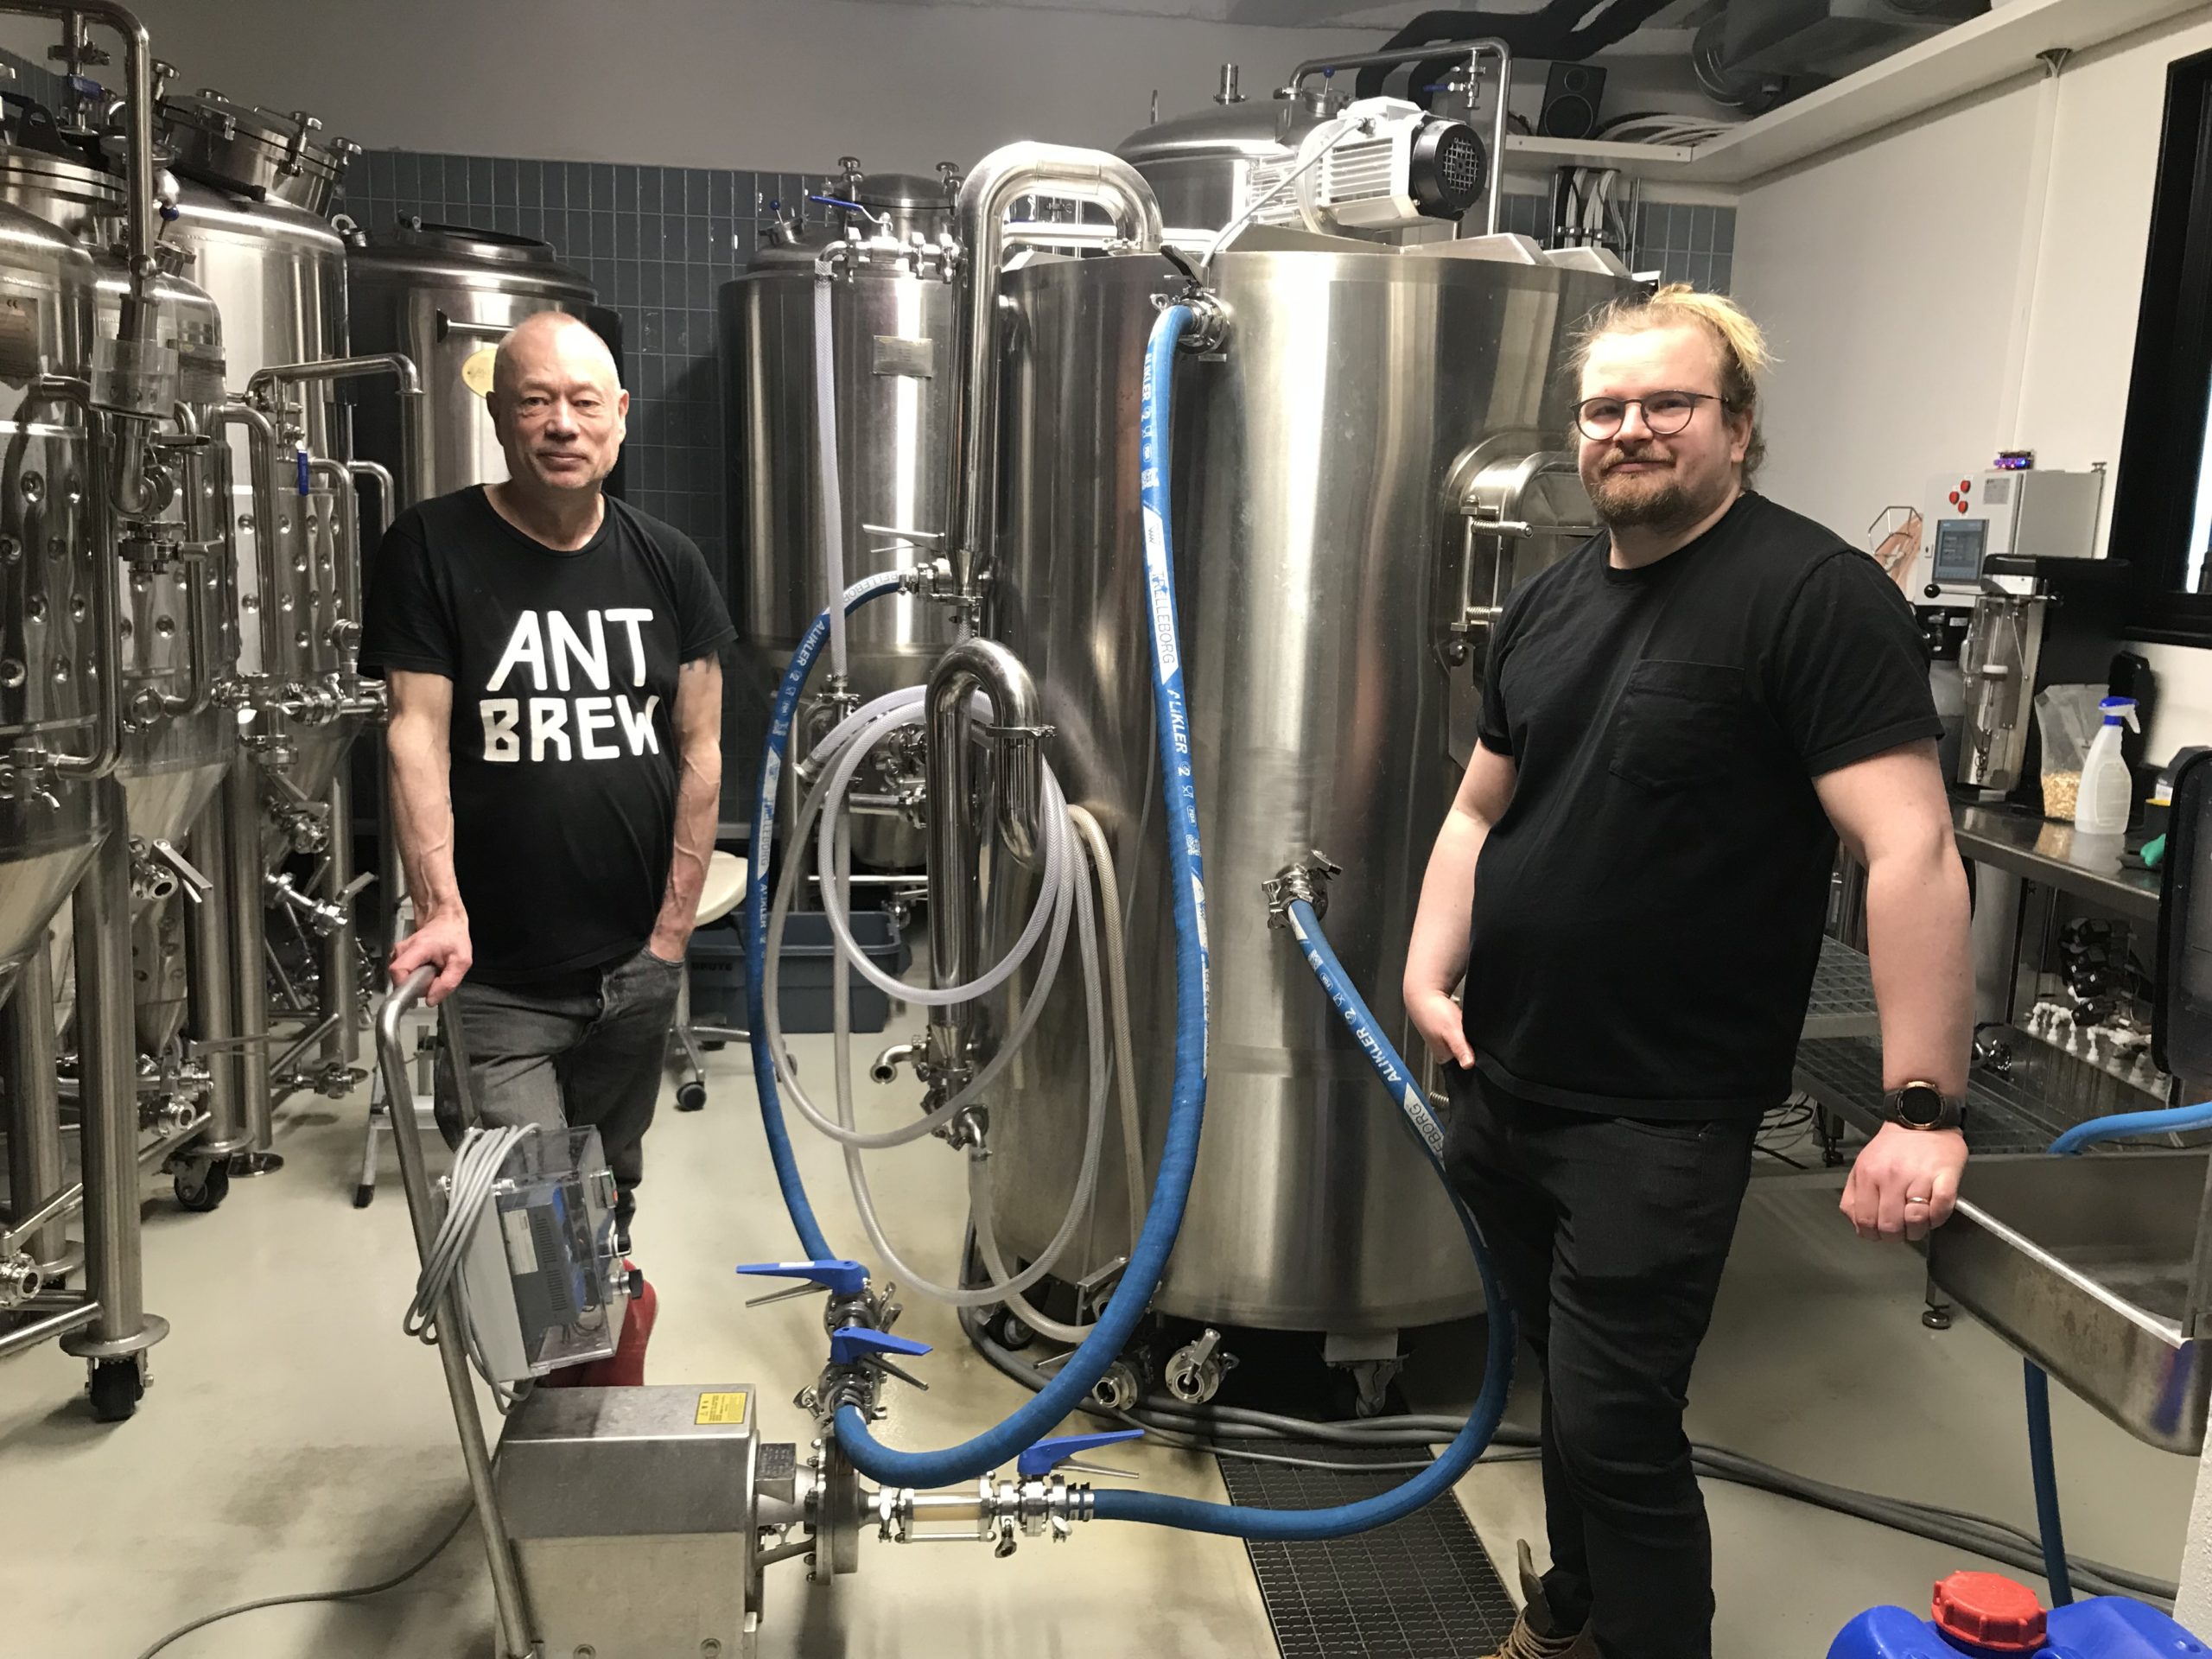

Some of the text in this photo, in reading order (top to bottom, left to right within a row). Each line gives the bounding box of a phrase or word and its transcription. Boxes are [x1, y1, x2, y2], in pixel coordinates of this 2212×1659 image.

[843, 573, 899, 603] RELLEBOR
[486, 608, 654, 691] ANT
[797, 620, 826, 666] ALIKLER
[1151, 571, 1175, 664] TRELLEBORG
[1167, 689, 1188, 754] ALIKLER
[479, 695, 660, 762] BREW
[1356, 1026, 1402, 1082] ALIKLER
[1409, 1103, 1445, 1154] EBORG
